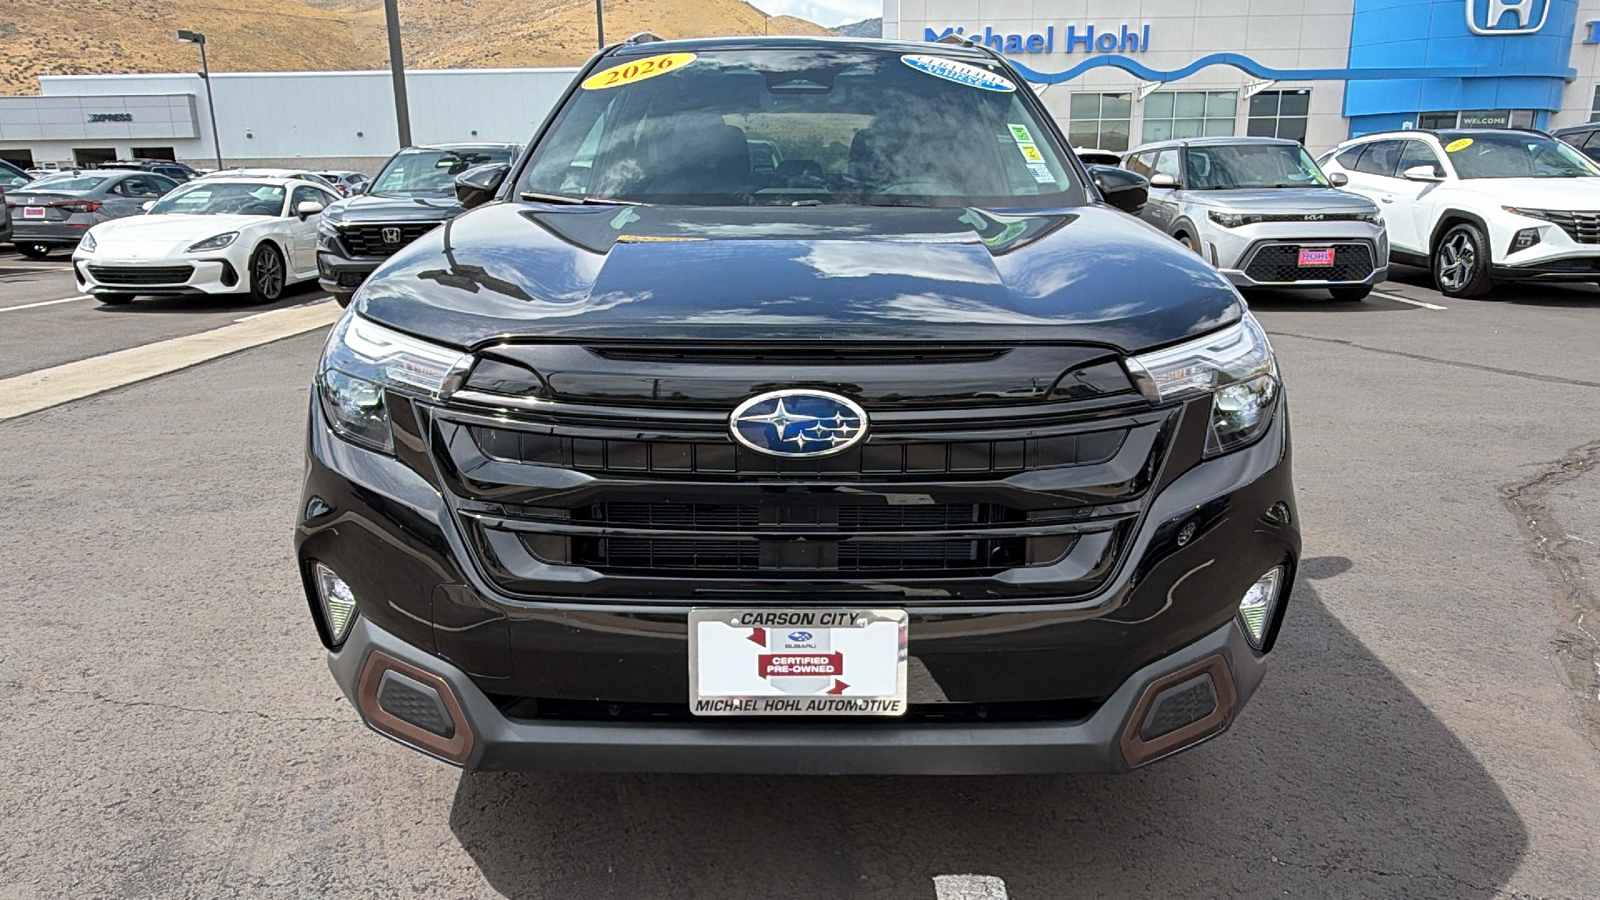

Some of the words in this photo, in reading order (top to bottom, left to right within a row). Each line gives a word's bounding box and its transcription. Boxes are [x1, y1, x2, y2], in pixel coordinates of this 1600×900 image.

[925, 26, 1054, 53] Mhael
[1065, 24, 1151, 53] Hohl
[603, 56, 673, 86] 2026
[1463, 117, 1506, 125] WELCOME
[1302, 252, 1329, 260] HOHL
[741, 612, 816, 626] CARSON
[820, 612, 860, 626] CITY
[772, 656, 829, 665] CERTIFIED
[766, 665, 835, 673] PRE-OWNED
[695, 699, 758, 712] MICHAEL
[764, 699, 802, 712] HOHL
[806, 699, 901, 712] AUTOMOTIVE
